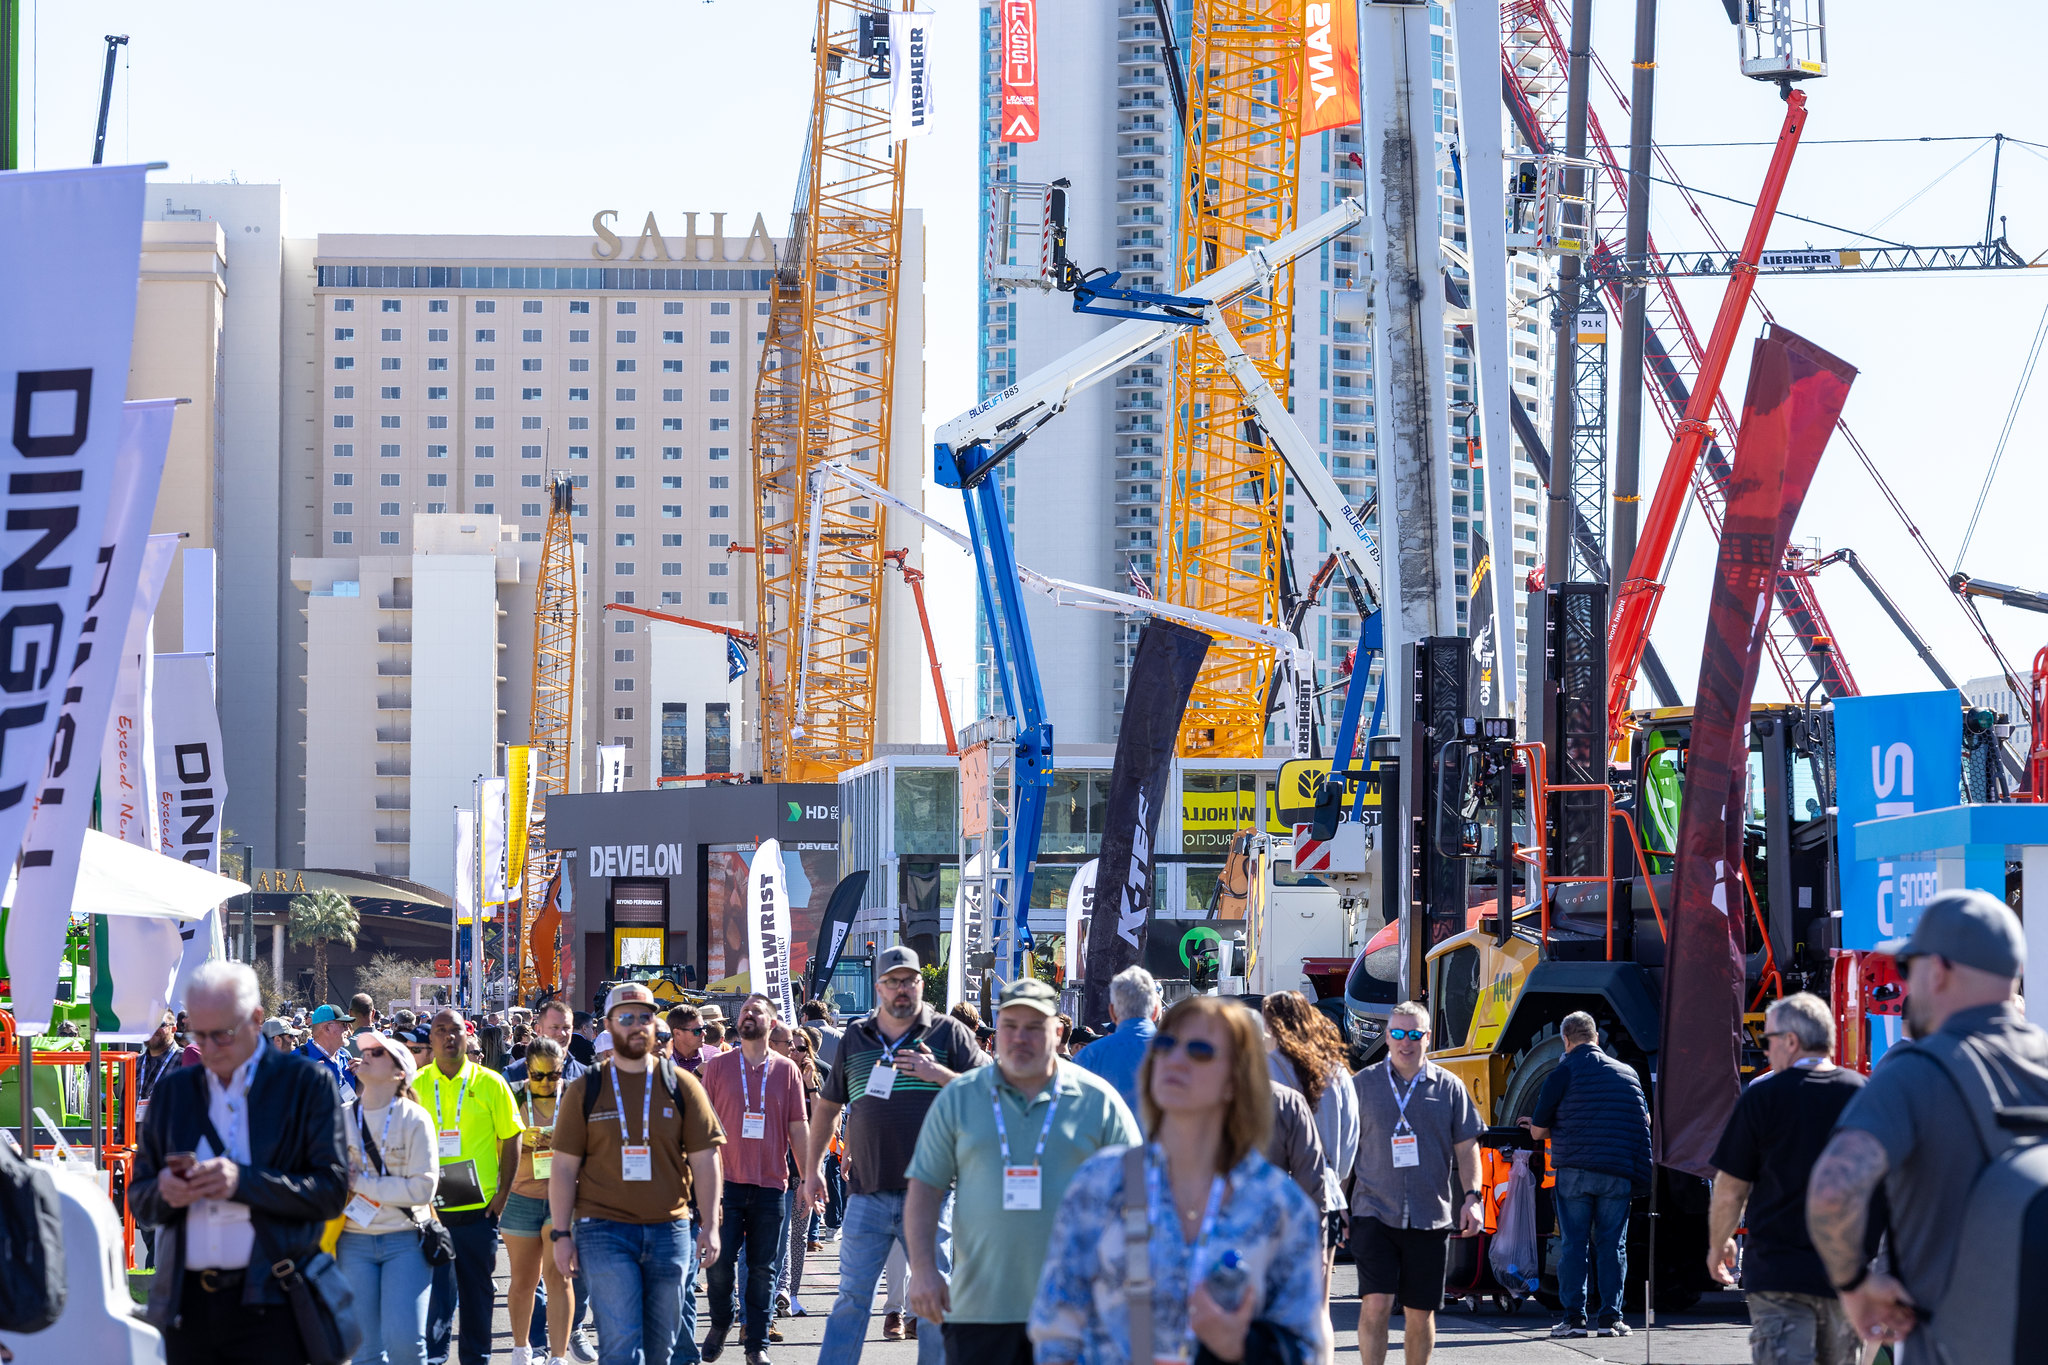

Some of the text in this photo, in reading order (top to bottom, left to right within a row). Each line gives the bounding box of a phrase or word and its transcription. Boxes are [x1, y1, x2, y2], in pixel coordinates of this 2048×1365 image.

[1010, 6, 1029, 79] FASSI
[910, 27, 925, 127] LIEBHERR
[1763, 255, 1831, 265] LIEBHERR
[1581, 320, 1602, 328] 91 K
[968, 384, 1020, 419] BLUELIFT B85
[1341, 504, 1375, 549] BLUELIFT
[1613, 599, 1626, 623] height
[1480, 649, 1495, 706] JEKKO
[1299, 679, 1311, 754] LIEBHERR
[806, 805, 828, 819] HD
[590, 844, 682, 877] DEVELON
[1566, 894, 1599, 905] VOLVO
[777, 936, 788, 976] EFFICIENCY
[1493, 972, 1512, 1003] A40
